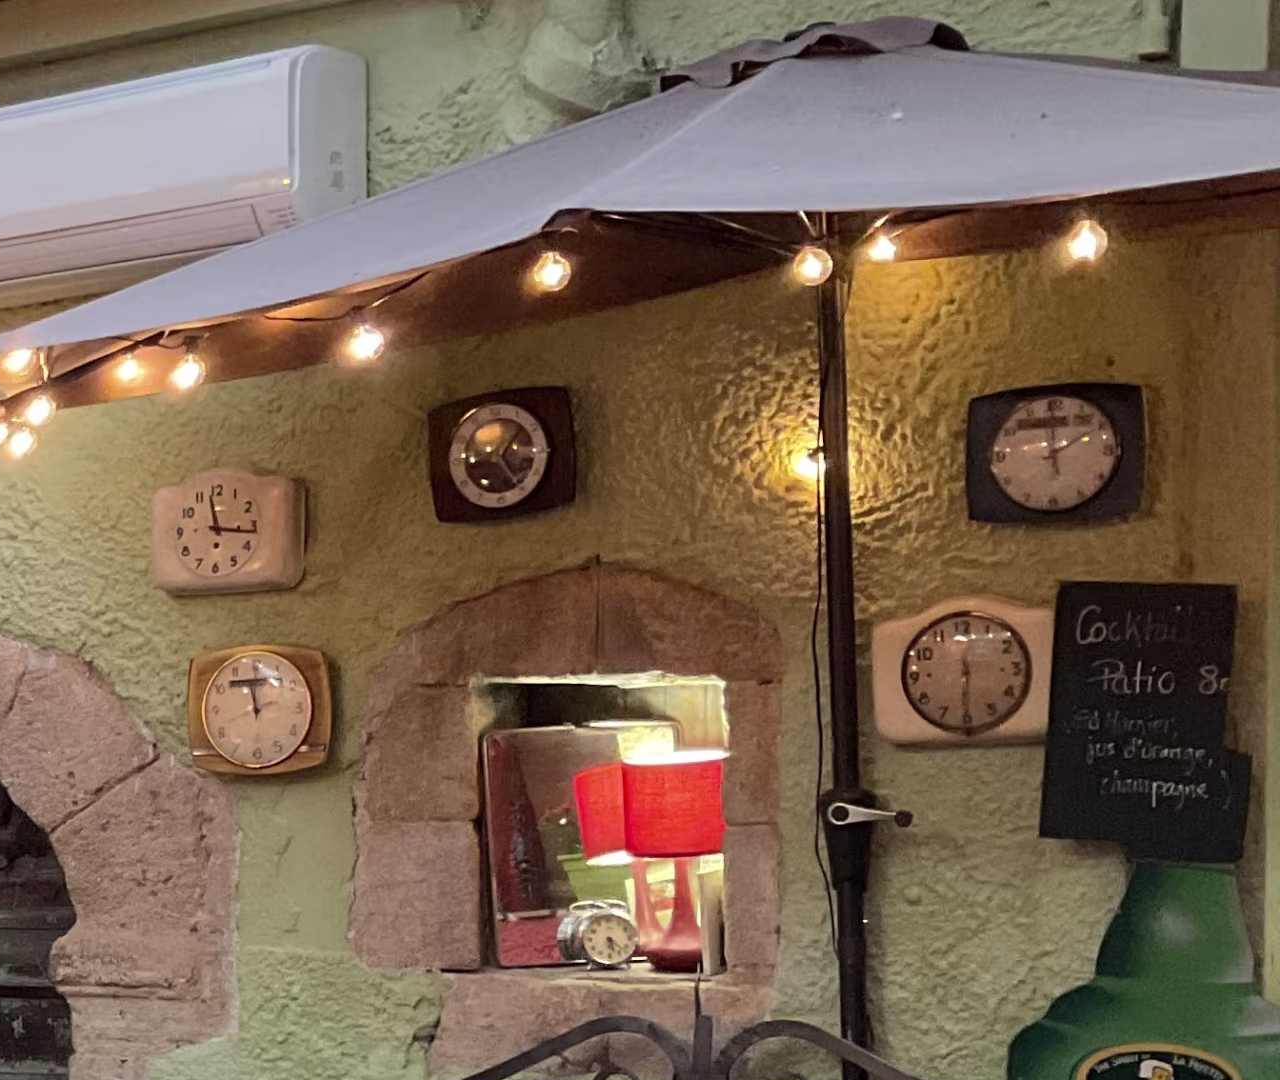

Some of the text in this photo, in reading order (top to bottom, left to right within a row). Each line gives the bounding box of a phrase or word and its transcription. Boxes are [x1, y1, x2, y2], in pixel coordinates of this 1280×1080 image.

[211, 484, 223, 497] 12
[233, 488, 237, 500] 1
[196, 491, 204, 504] 11
[244, 500, 252, 513] 2
[182, 507, 195, 519] 10
[177, 526, 184, 539] 9
[181, 545, 191, 557] 8
[242, 540, 251, 552] 4
[195, 558, 203, 570] 7
[230, 555, 238, 567] 5
[212, 562, 219, 574] 6
[1088, 659, 1175, 694] Patio
